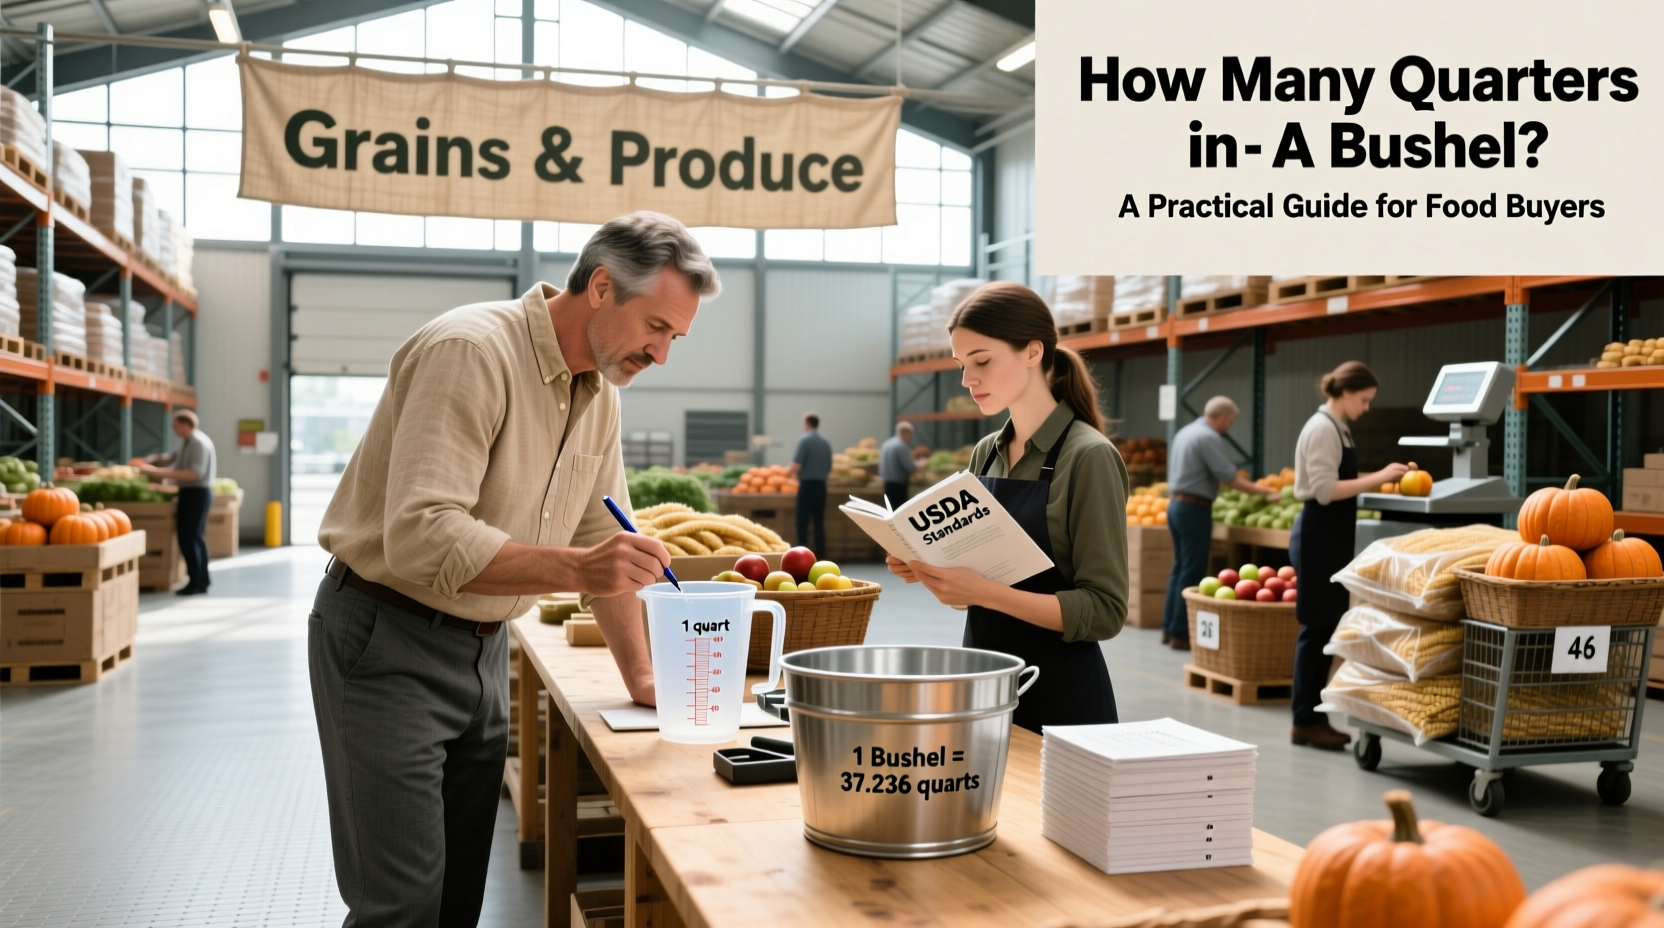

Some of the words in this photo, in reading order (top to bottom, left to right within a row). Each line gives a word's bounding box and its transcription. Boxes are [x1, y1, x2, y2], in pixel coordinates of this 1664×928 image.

[284, 109, 511, 180] Grains
[534, 126, 584, 183] &
[610, 129, 864, 193] Produce
[908, 489, 980, 532] USDA
[922, 506, 991, 546] Standards
[681, 619, 689, 632] 1
[693, 618, 731, 636] quart
[1567, 635, 1596, 660] 46
[852, 745, 863, 766] 1
[871, 745, 946, 767] Bushel
[952, 750, 965, 762] =
[840, 771, 912, 795] 37.236
[916, 772, 980, 801] quarts
